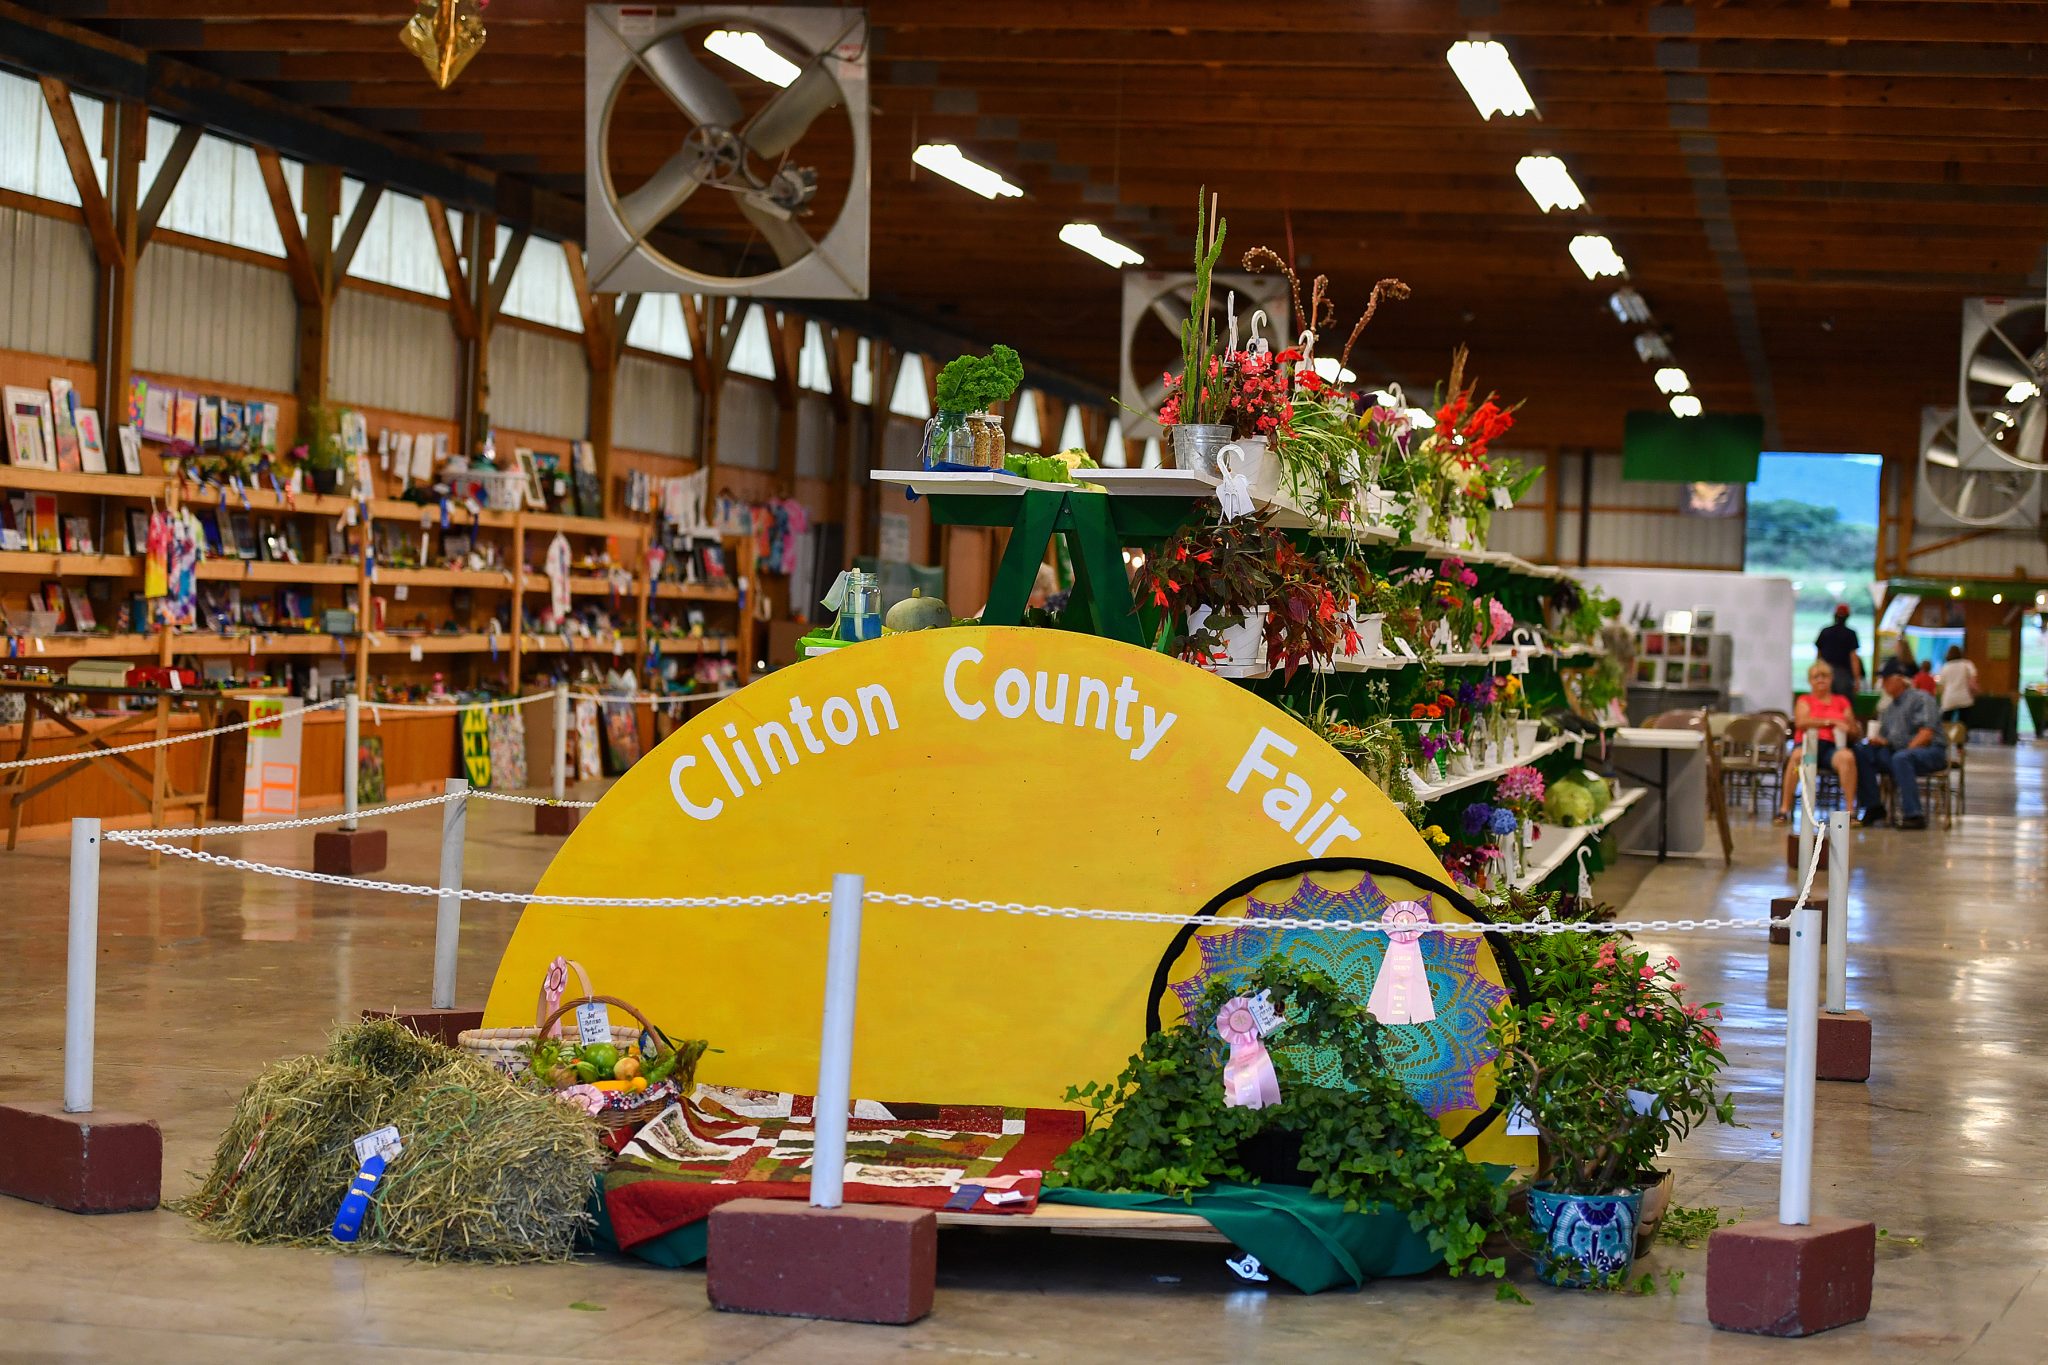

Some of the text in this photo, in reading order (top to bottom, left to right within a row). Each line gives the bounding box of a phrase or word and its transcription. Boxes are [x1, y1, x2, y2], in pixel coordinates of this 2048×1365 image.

[668, 645, 1362, 859] Clinton County Fair
